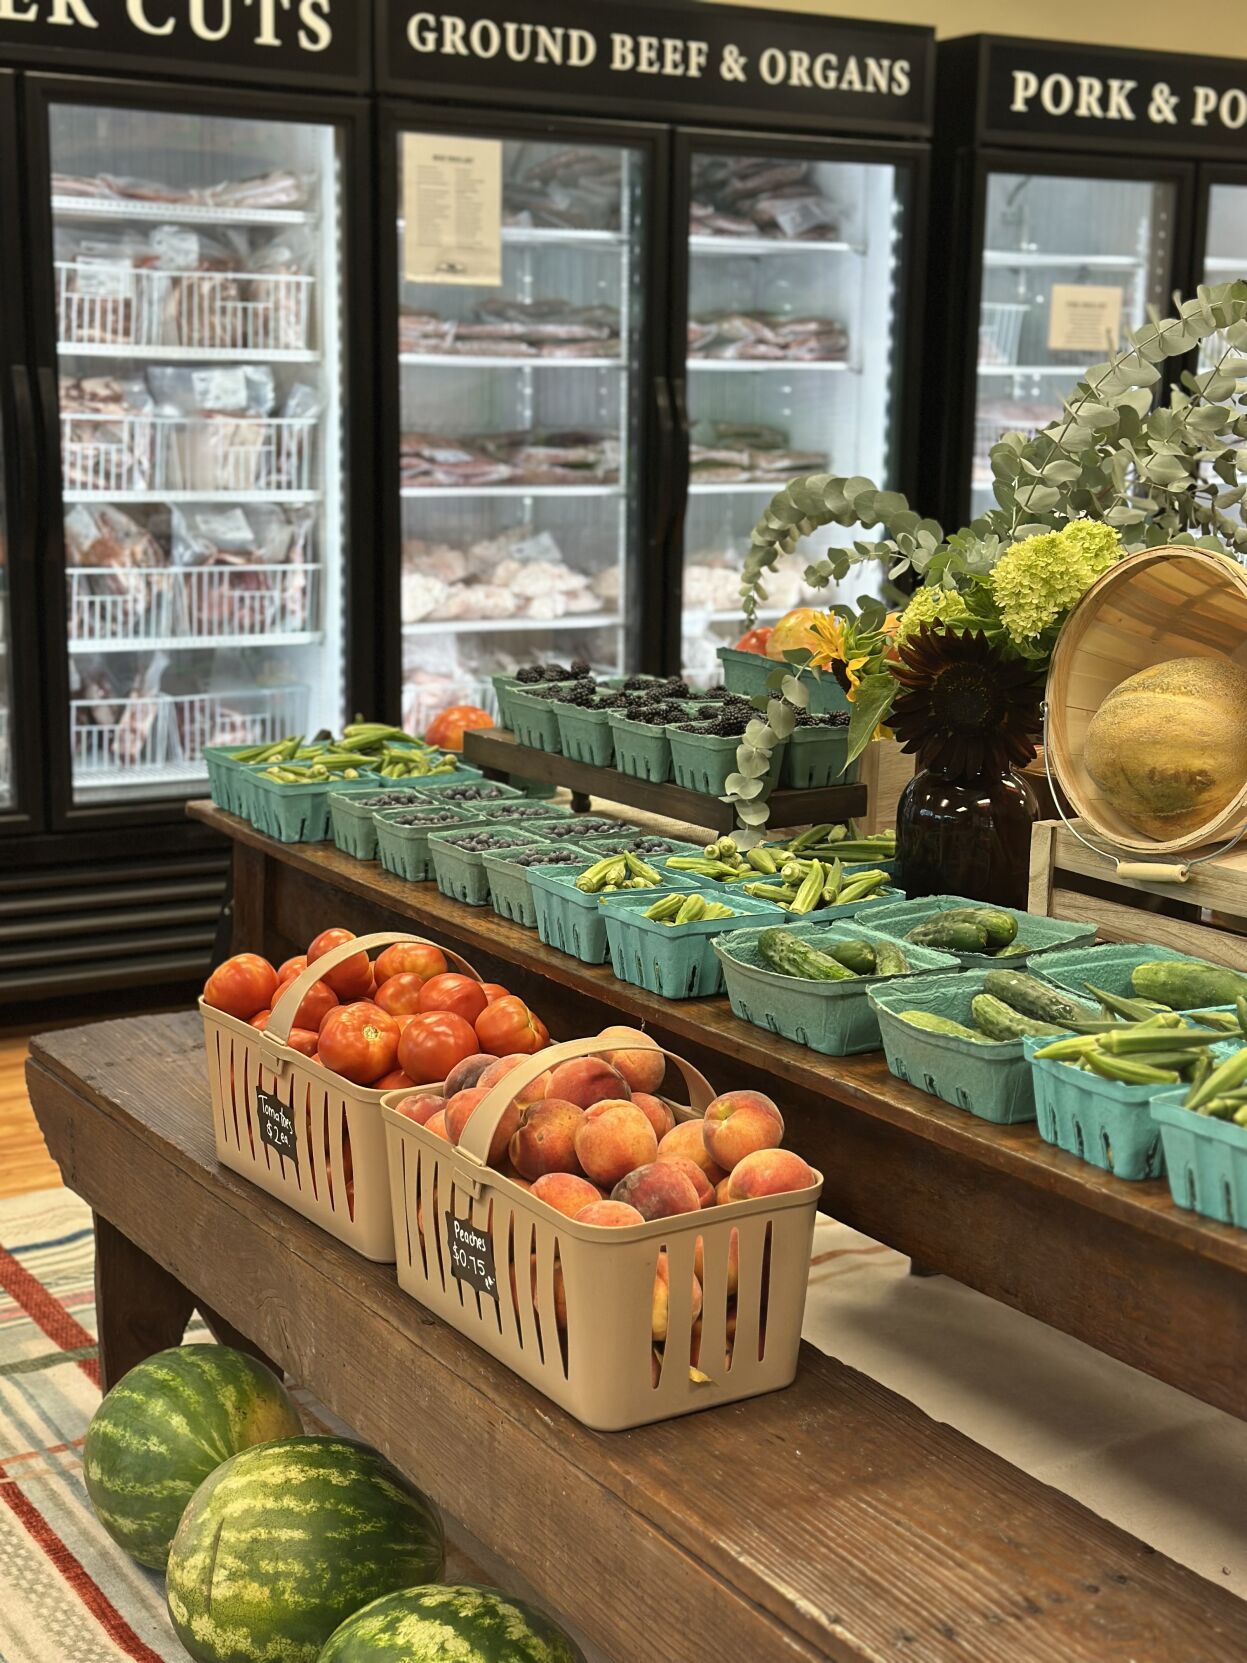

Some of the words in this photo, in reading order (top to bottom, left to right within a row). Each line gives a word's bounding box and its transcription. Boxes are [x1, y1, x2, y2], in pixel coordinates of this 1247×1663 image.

[127, 0, 332, 52] CUTS
[407, 12, 597, 67] GROUND
[610, 33, 708, 78] BEEF
[720, 44, 747, 82] &
[759, 47, 911, 97] ORGANS
[1011, 70, 1137, 120] PORK
[1148, 82, 1180, 125] &
[1191, 86, 1247, 129] PO
[452, 1241, 486, 1276] $0.75
